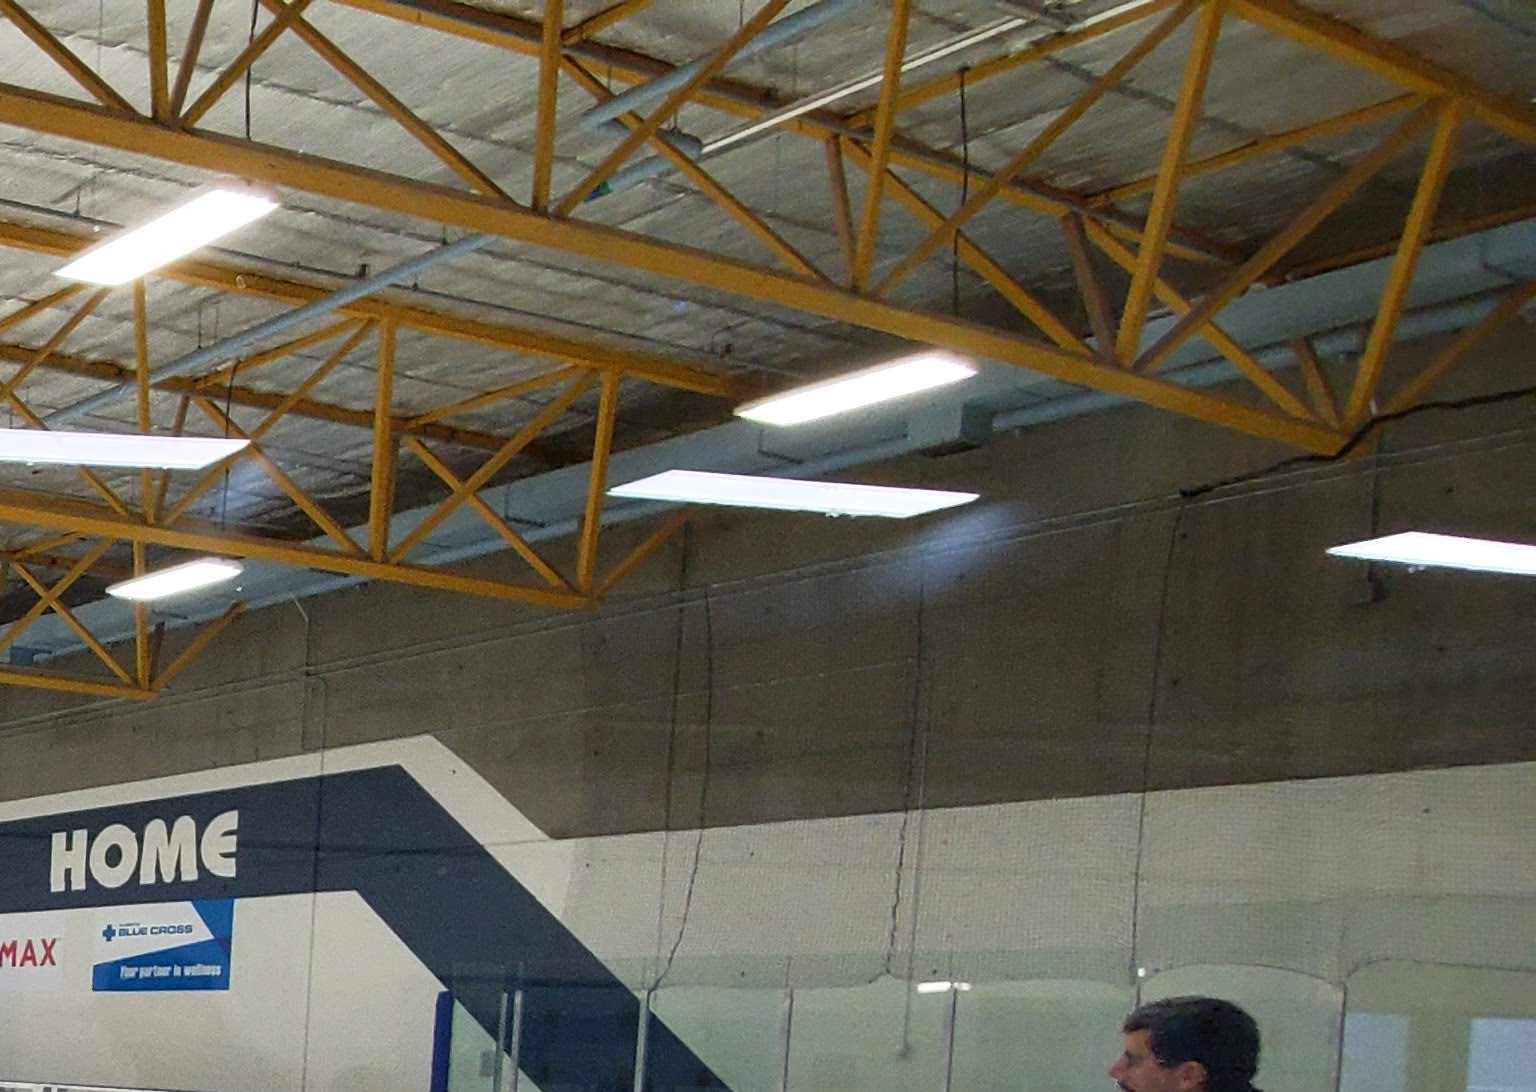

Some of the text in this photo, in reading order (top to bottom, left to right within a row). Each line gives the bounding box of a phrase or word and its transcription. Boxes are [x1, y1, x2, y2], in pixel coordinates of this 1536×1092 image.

[50, 810, 239, 893] HOME
[119, 927, 147, 936] BLUE
[150, 924, 193, 934] CROSS
